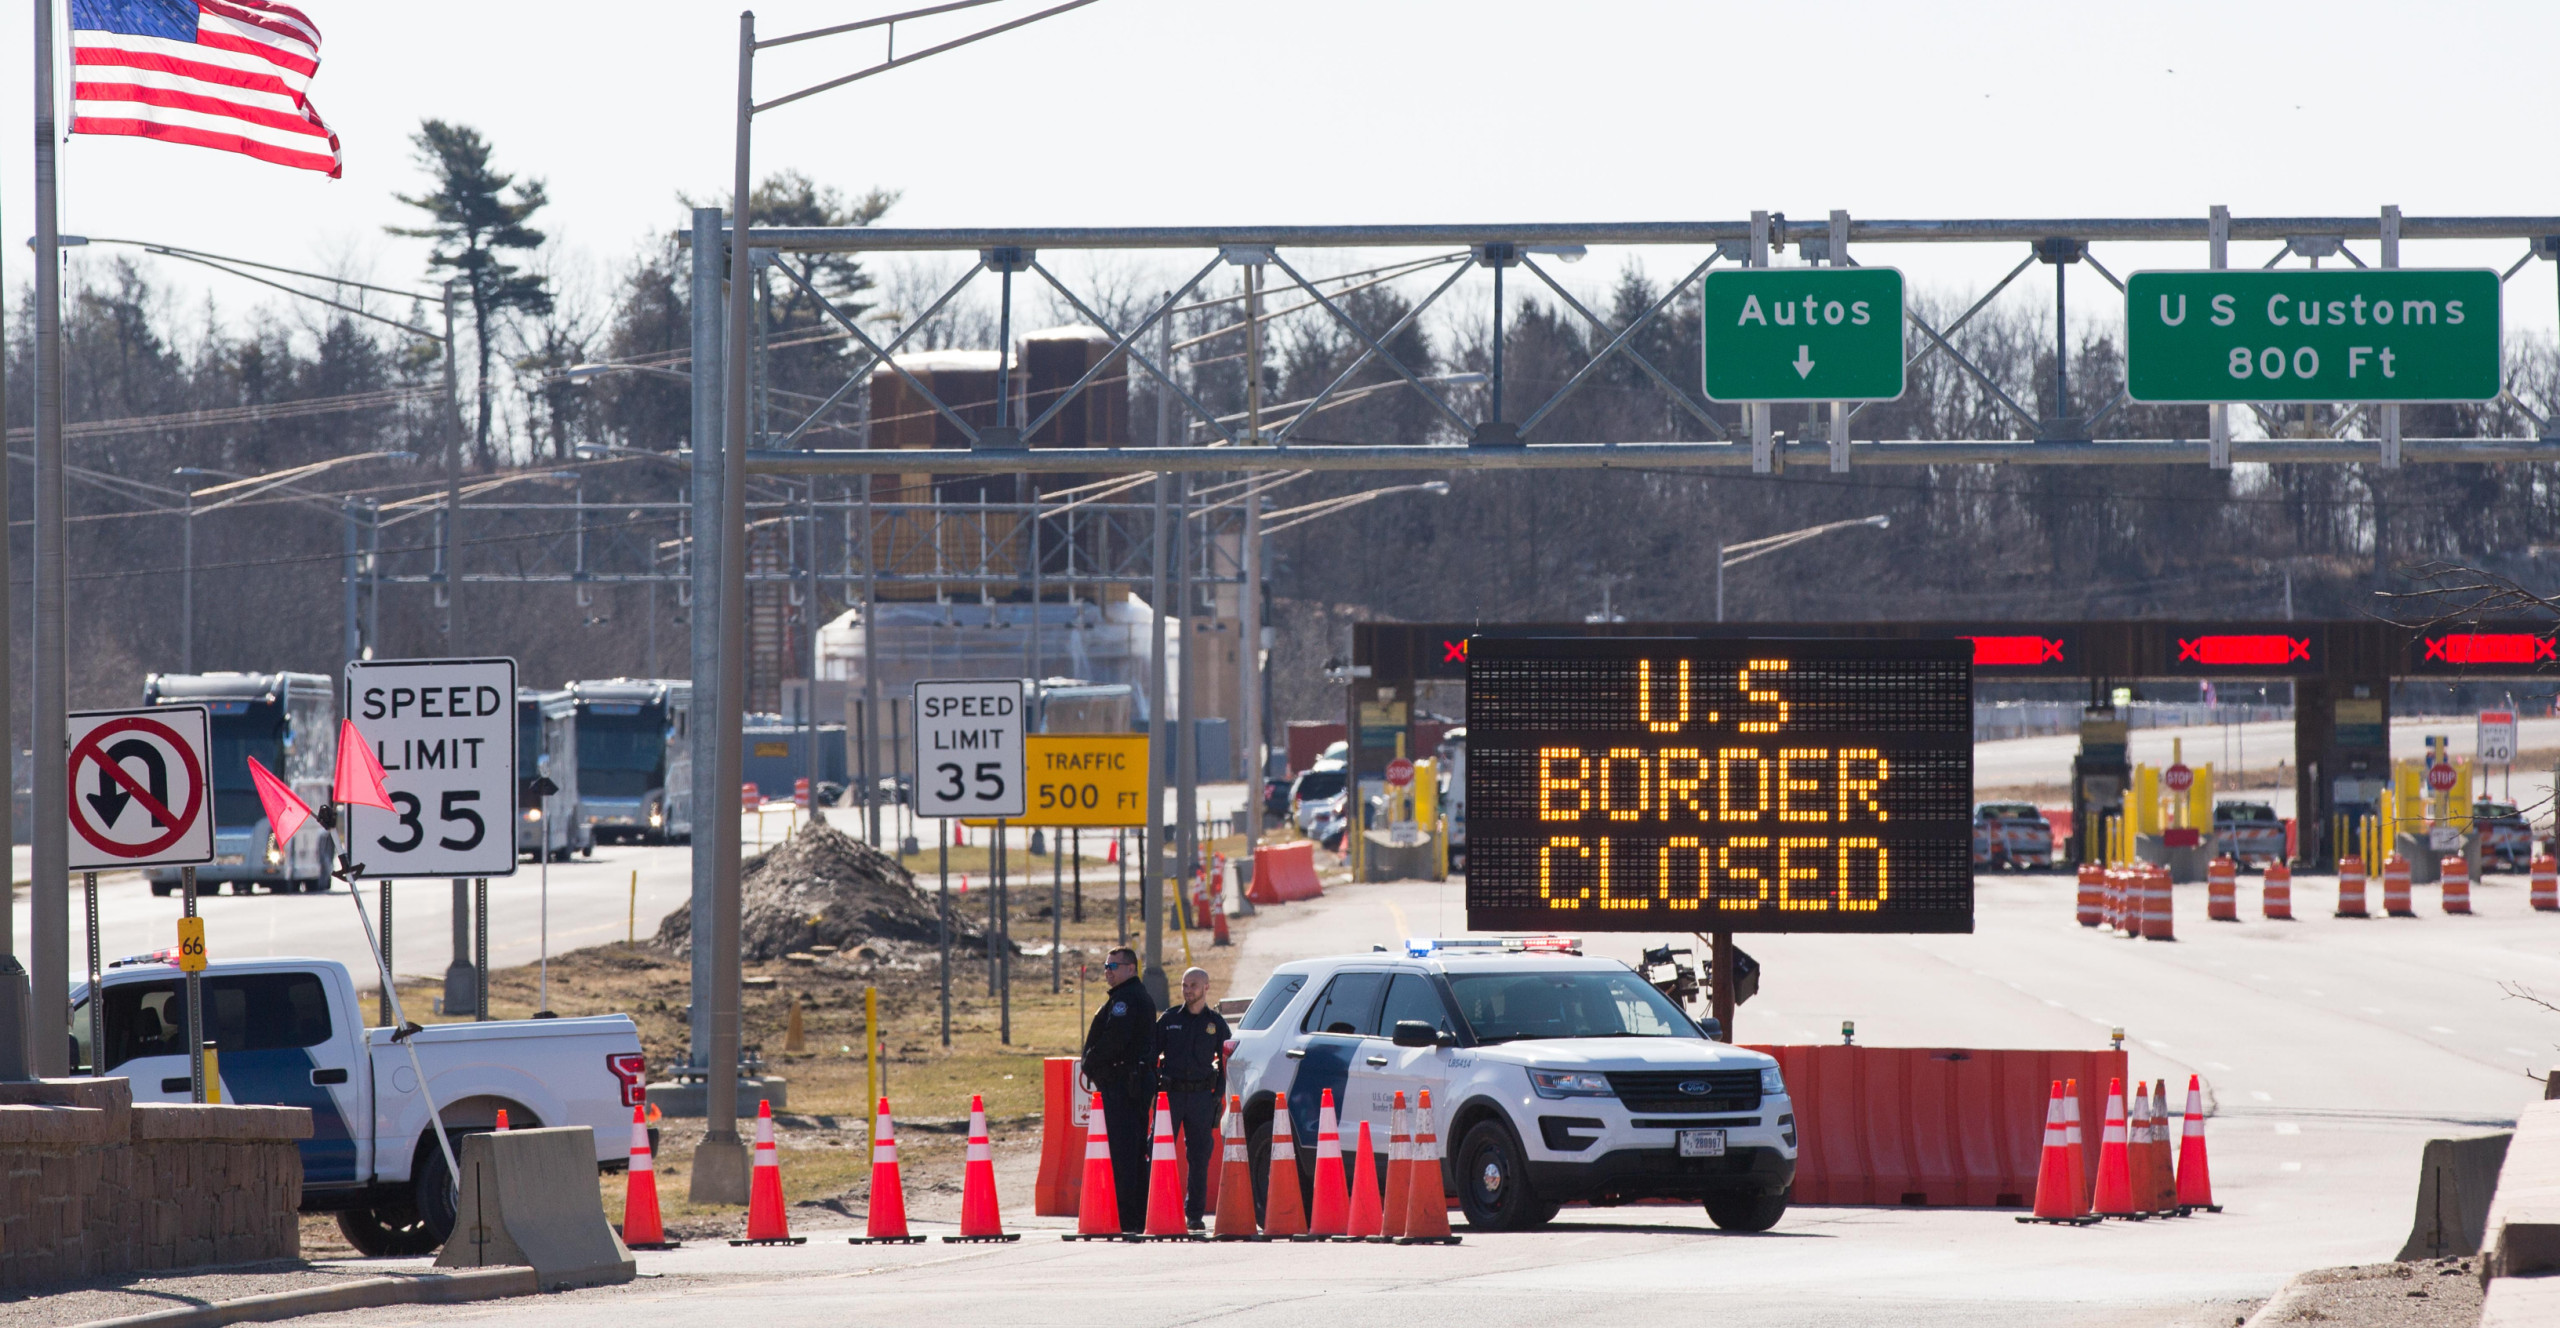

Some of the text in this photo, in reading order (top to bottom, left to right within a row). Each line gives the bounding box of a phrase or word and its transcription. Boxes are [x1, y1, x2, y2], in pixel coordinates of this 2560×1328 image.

[1738, 294, 1870, 326] Autos
[2160, 294, 2465, 326] U S Customs
[2228, 346, 2396, 379] 800 Ft
[362, 686, 501, 720] SPEED
[924, 696, 1014, 718] SPEED
[1639, 659, 1789, 733] U.S
[934, 729, 1004, 750] LIMIT
[2484, 745, 2509, 760] 40
[378, 738, 485, 770] LIMIT
[1045, 753, 1126, 771] TRAFFIC
[935, 763, 1005, 801] 35
[1388, 766, 1415, 779] STOP
[1539, 747, 1889, 822] BORDER
[2167, 771, 2192, 785] STOP
[2430, 771, 2457, 785] STOP
[1039, 784, 1139, 809] 500 FT
[377, 790, 486, 853] 35
[1539, 835, 1889, 911] CLOSED
[182, 936, 204, 956] 66
[1687, 1083, 1705, 1092] Ford
